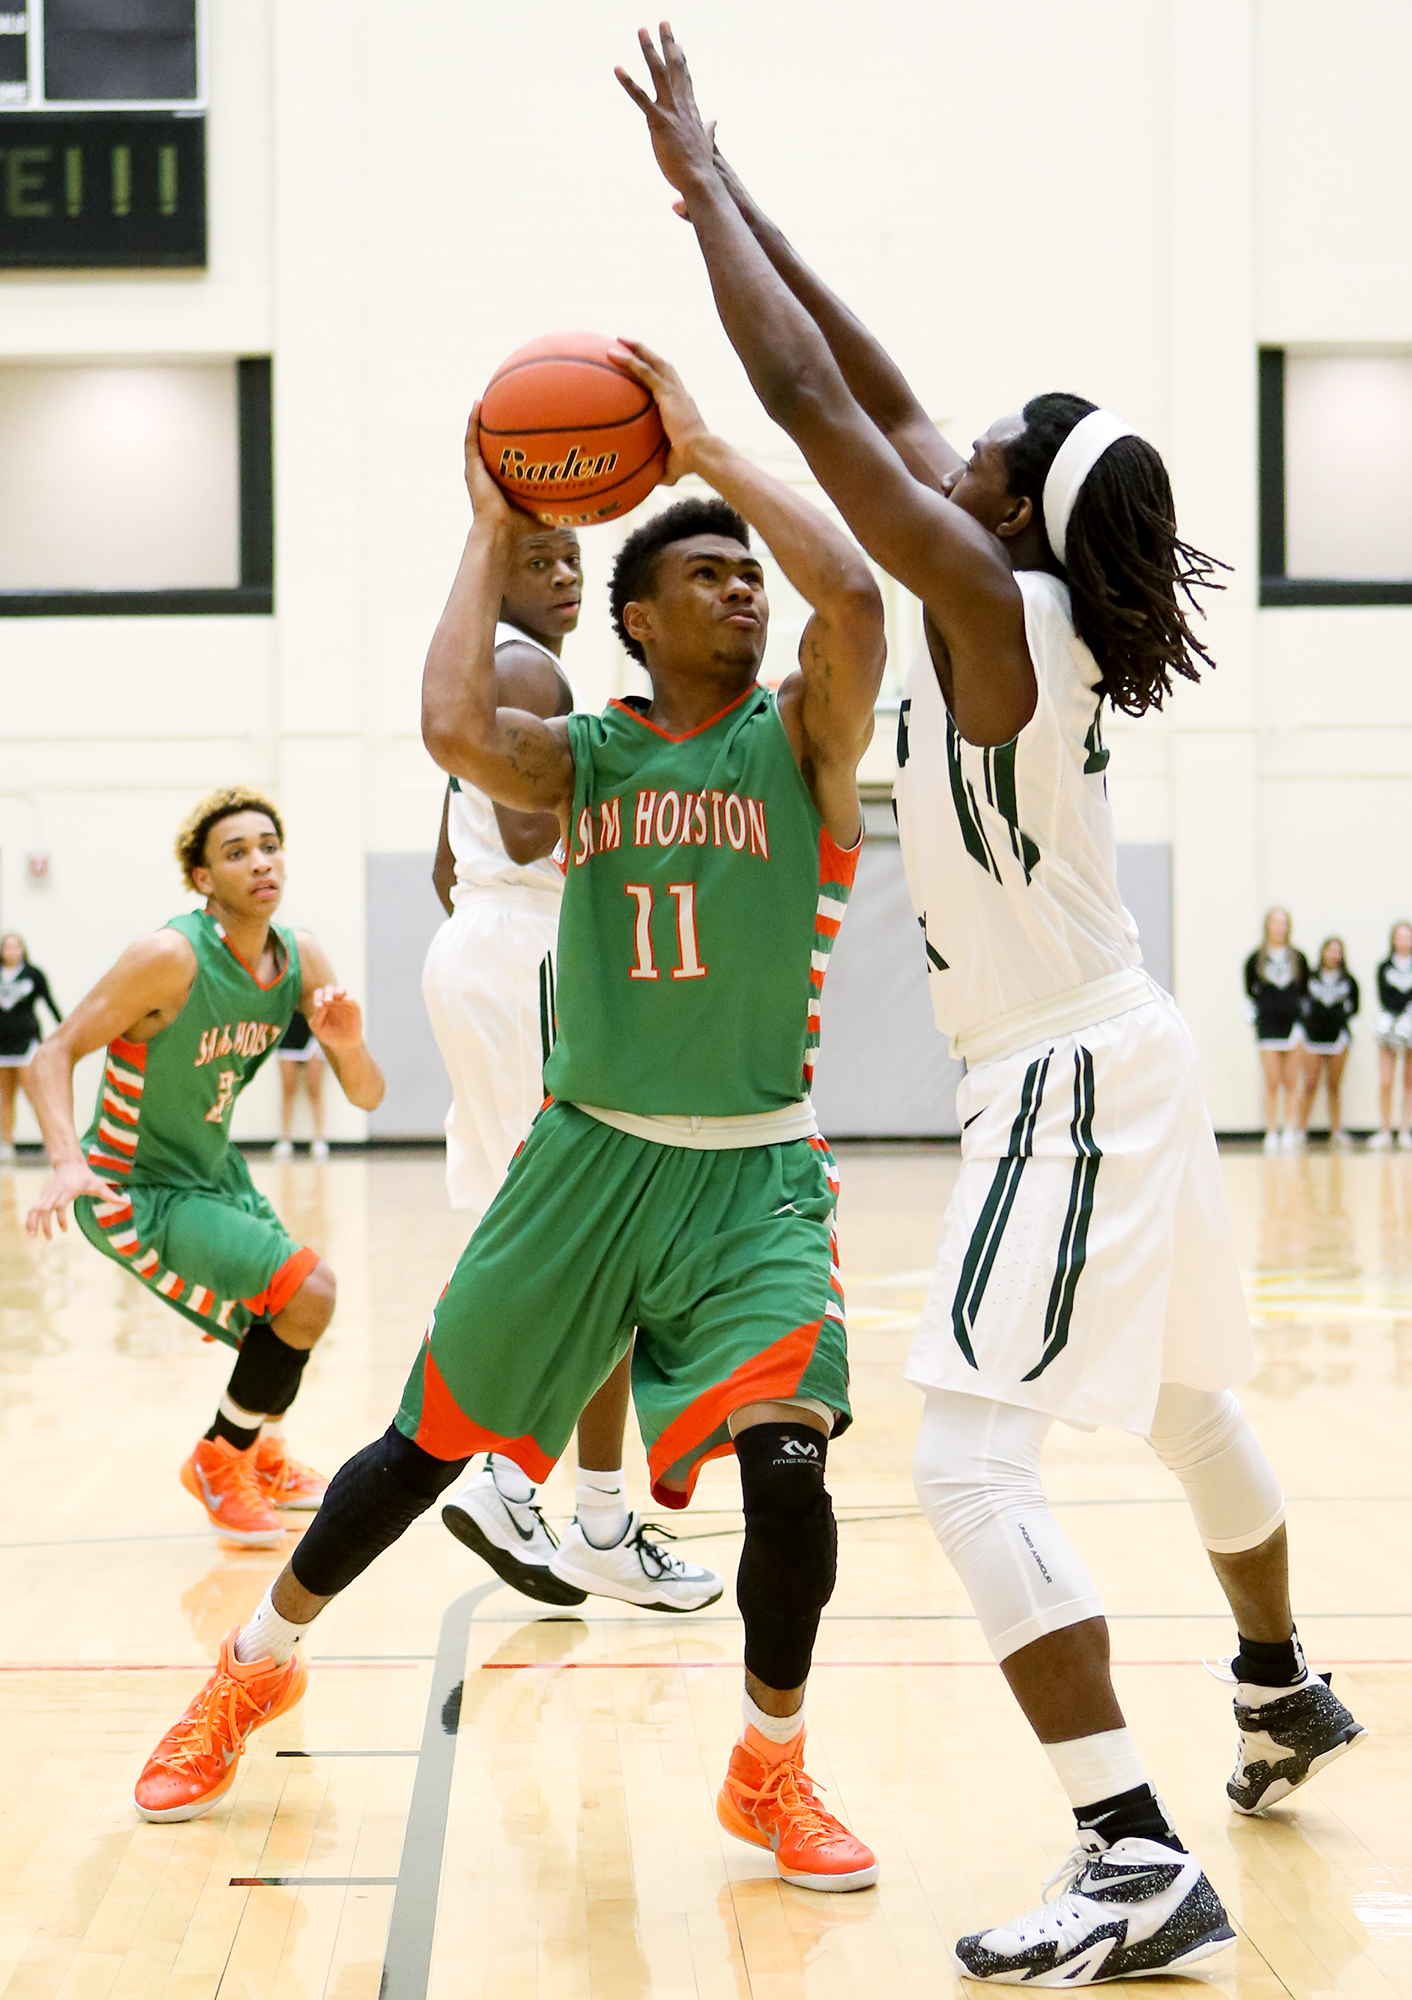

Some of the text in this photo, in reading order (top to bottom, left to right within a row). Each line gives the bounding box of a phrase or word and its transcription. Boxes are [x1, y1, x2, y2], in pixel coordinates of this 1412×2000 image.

[0, 147, 178, 217] E!!!
[500, 446, 618, 482] Baden
[625, 882, 708, 981] 11
[1018, 1523, 1052, 1583] UNDER ARMOUR
